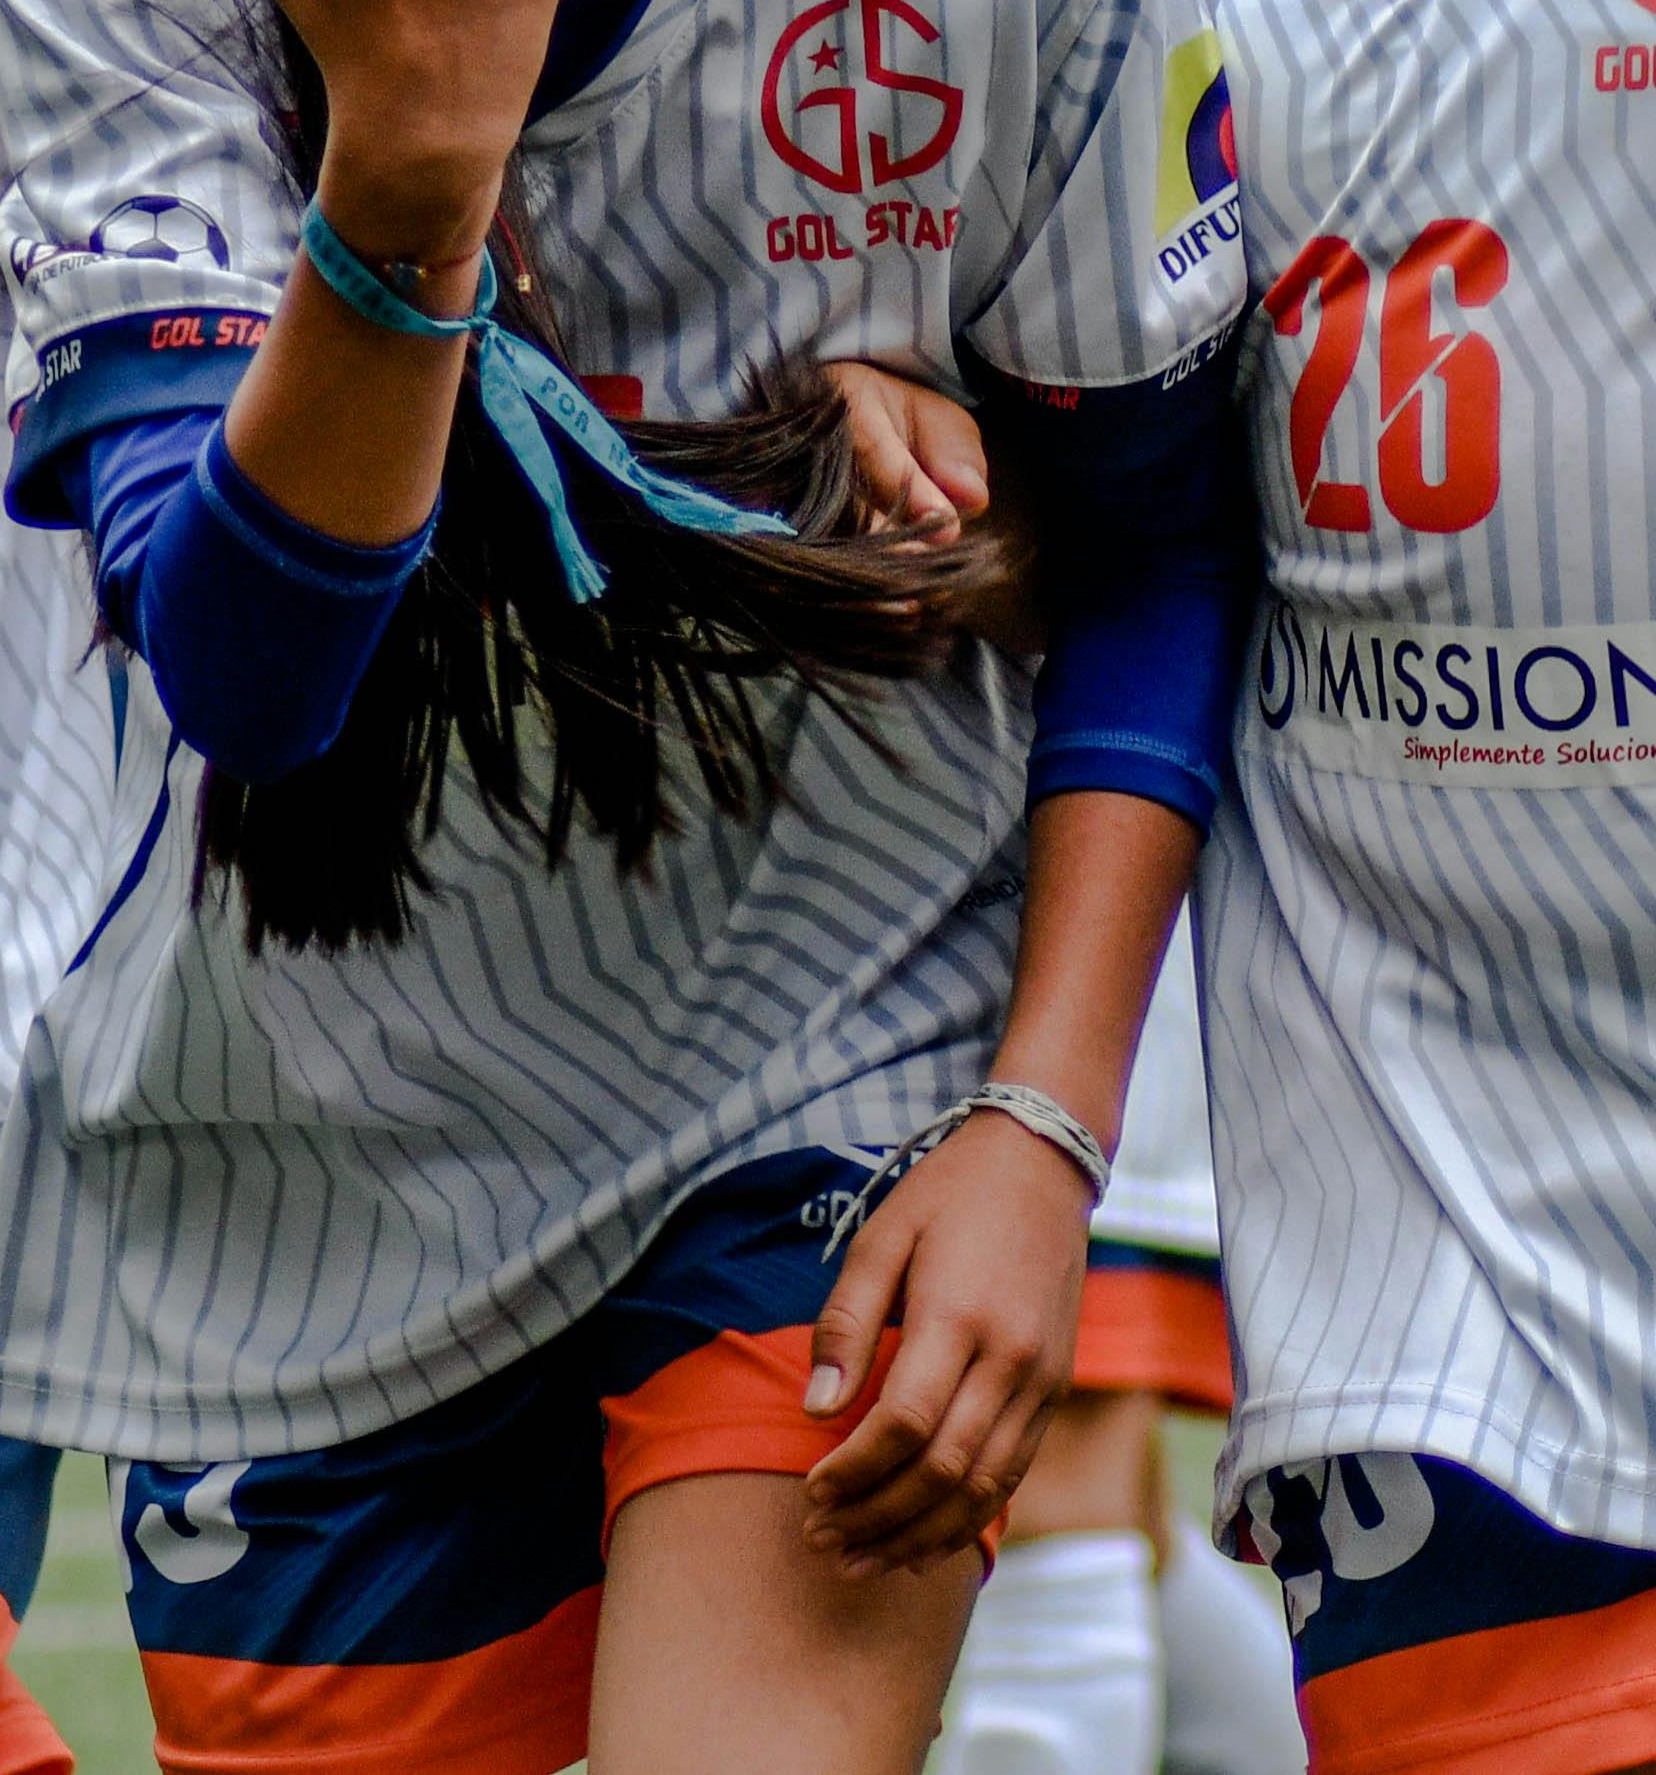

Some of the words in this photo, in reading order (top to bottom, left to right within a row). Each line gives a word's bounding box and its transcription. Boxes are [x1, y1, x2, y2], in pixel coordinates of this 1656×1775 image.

[766, 213, 854, 263] GOL
[150, 316, 206, 350] GOL
[44, 339, 82, 387] STAR
[1262, 218, 1509, 534] 26
[1403, 735, 1546, 772] Simplemente
